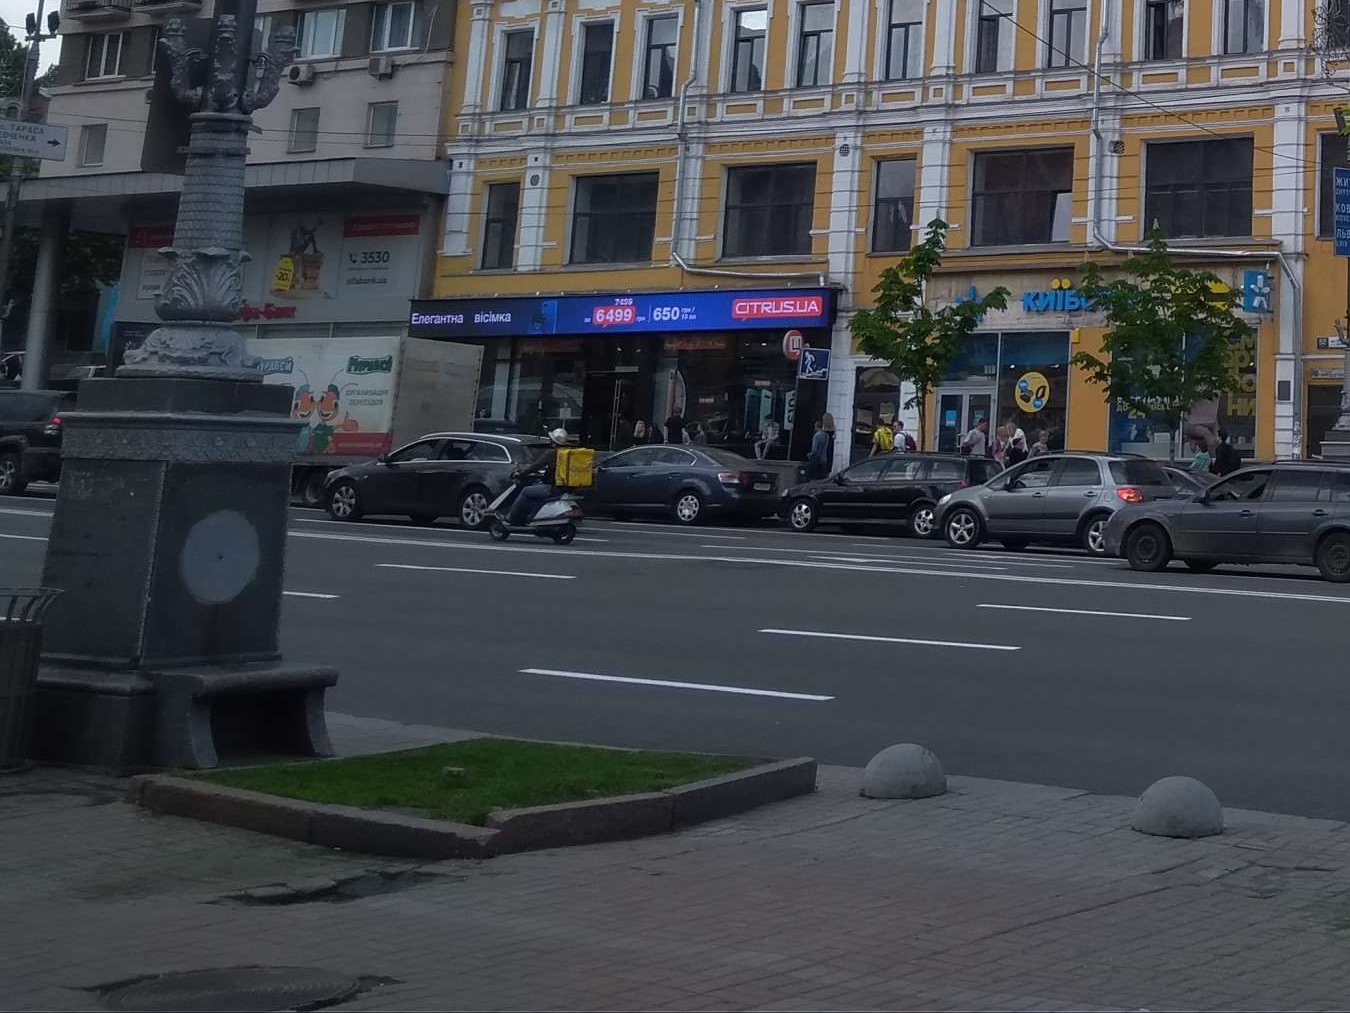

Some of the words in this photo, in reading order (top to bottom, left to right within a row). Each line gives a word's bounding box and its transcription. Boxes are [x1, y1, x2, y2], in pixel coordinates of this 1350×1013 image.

[11, 124, 45, 135] ТАРАСА
[360, 251, 390, 264] 3530
[653, 306, 681, 321] 650
[735, 299, 819, 315] CITRUS.UA
[411, 312, 464, 325] Елегантна
[474, 310, 511, 323] вісімка
[595, 308, 632, 323] 6499
[257, 359, 293, 373] УРАВЕЙ
[346, 389, 389, 397] ОРГАНИЗАЦИЯ
[349, 398, 384, 406] ПЕРЕЕЗДОВ
